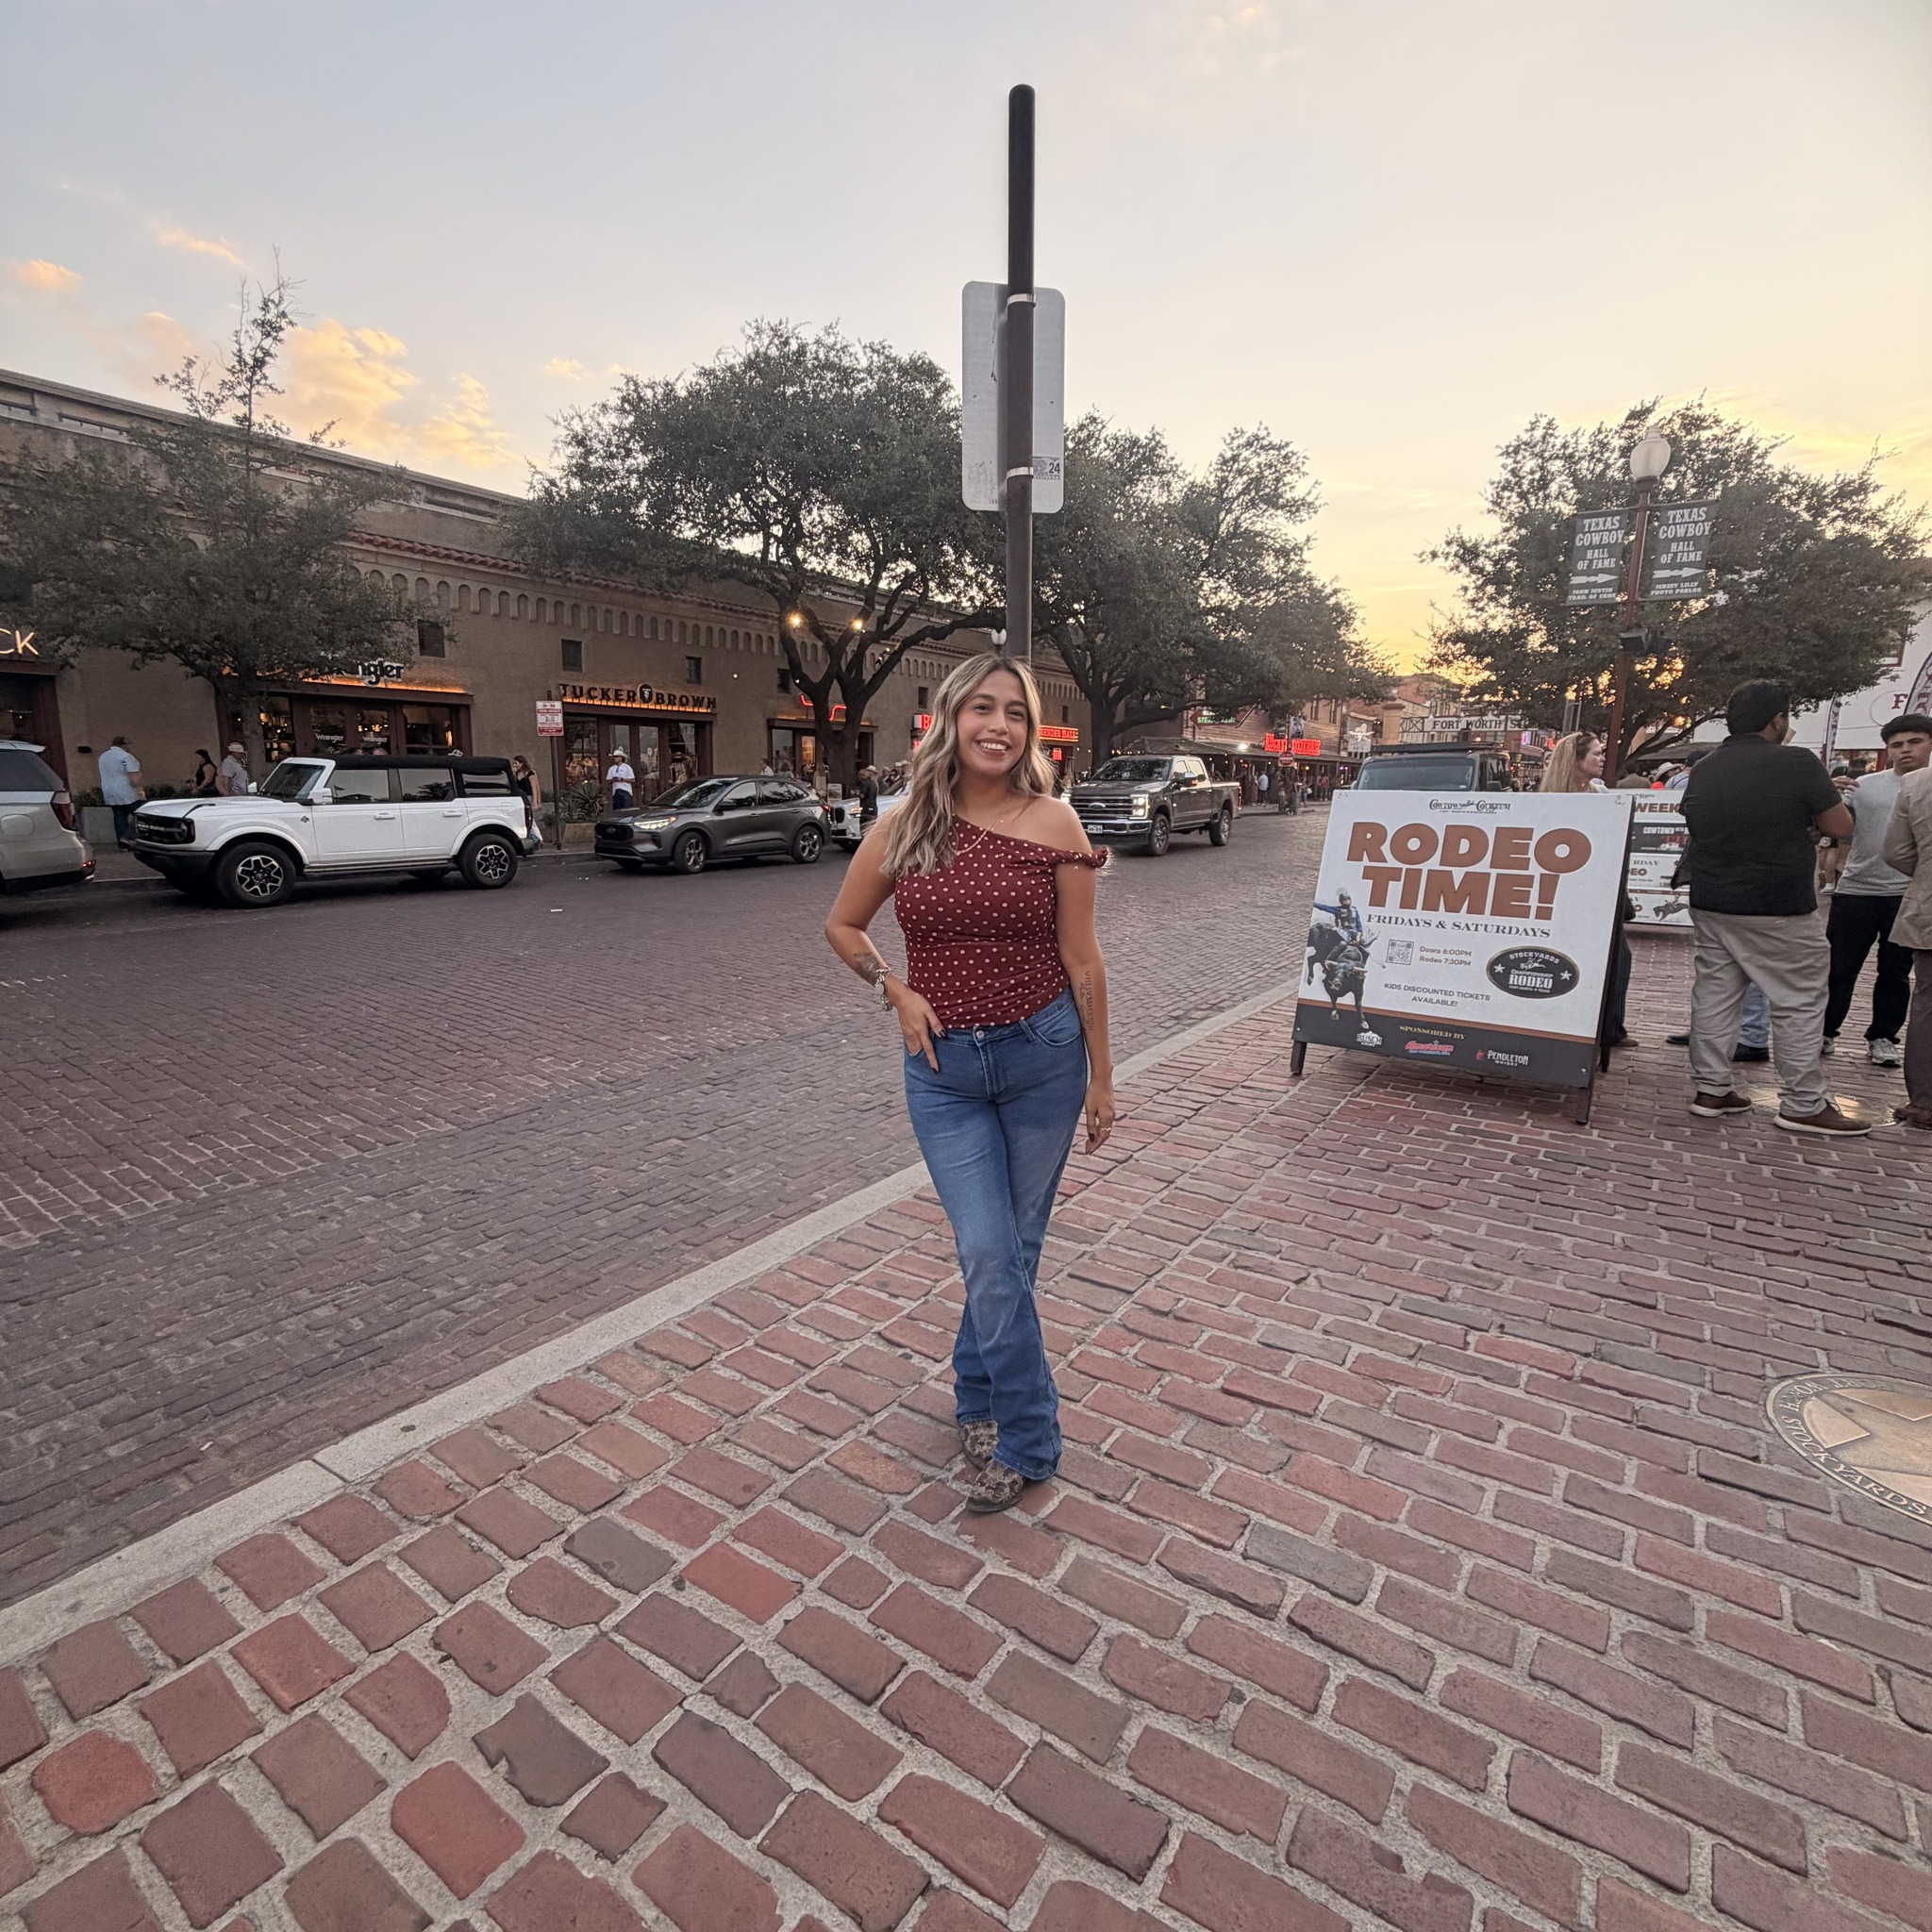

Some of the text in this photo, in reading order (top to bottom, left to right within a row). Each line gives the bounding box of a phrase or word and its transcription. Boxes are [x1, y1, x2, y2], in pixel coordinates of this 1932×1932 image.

[1049, 462, 1060, 474] 24
[1668, 507, 1707, 524] TEXAS
[1584, 516, 1620, 531] TEXAS
[1659, 521, 1712, 539] COWBOY
[1575, 529, 1624, 546] COWBOY
[1586, 548, 1608, 559] HALL
[1670, 541, 1694, 553] HALL
[1660, 551, 1703, 564] OF FAME
[1577, 558, 1616, 571] OF FAME
[558, 683, 638, 704] TUCKER
[655, 692, 717, 708] BROWN
[1432, 720, 1461, 729] FORT
[1465, 719, 1505, 729] WORTH
[1346, 822, 1591, 874] RODEO
[1361, 865, 1560, 921] TIME!
[1366, 914, 1551, 938] FRIDAYS & SATURDAYS
[1420, 946, 1472, 957] Doors 6:00PM
[1509, 952, 1560, 964] STOCKYARDS
[1419, 956, 1472, 966] Rodeo 7:30PM
[1508, 974, 1553, 989] RODEO
[1404, 984, 1455, 997] DISCOUNTED
[1457, 991, 1491, 1001] TICKETS
[1411, 995, 1458, 1007] AVAILABLE!
[1399, 1025, 1452, 1038] SPONSORED
[1357, 1034, 1383, 1046] BUSCH
[1487, 1050, 1529, 1065] PENDLETON
